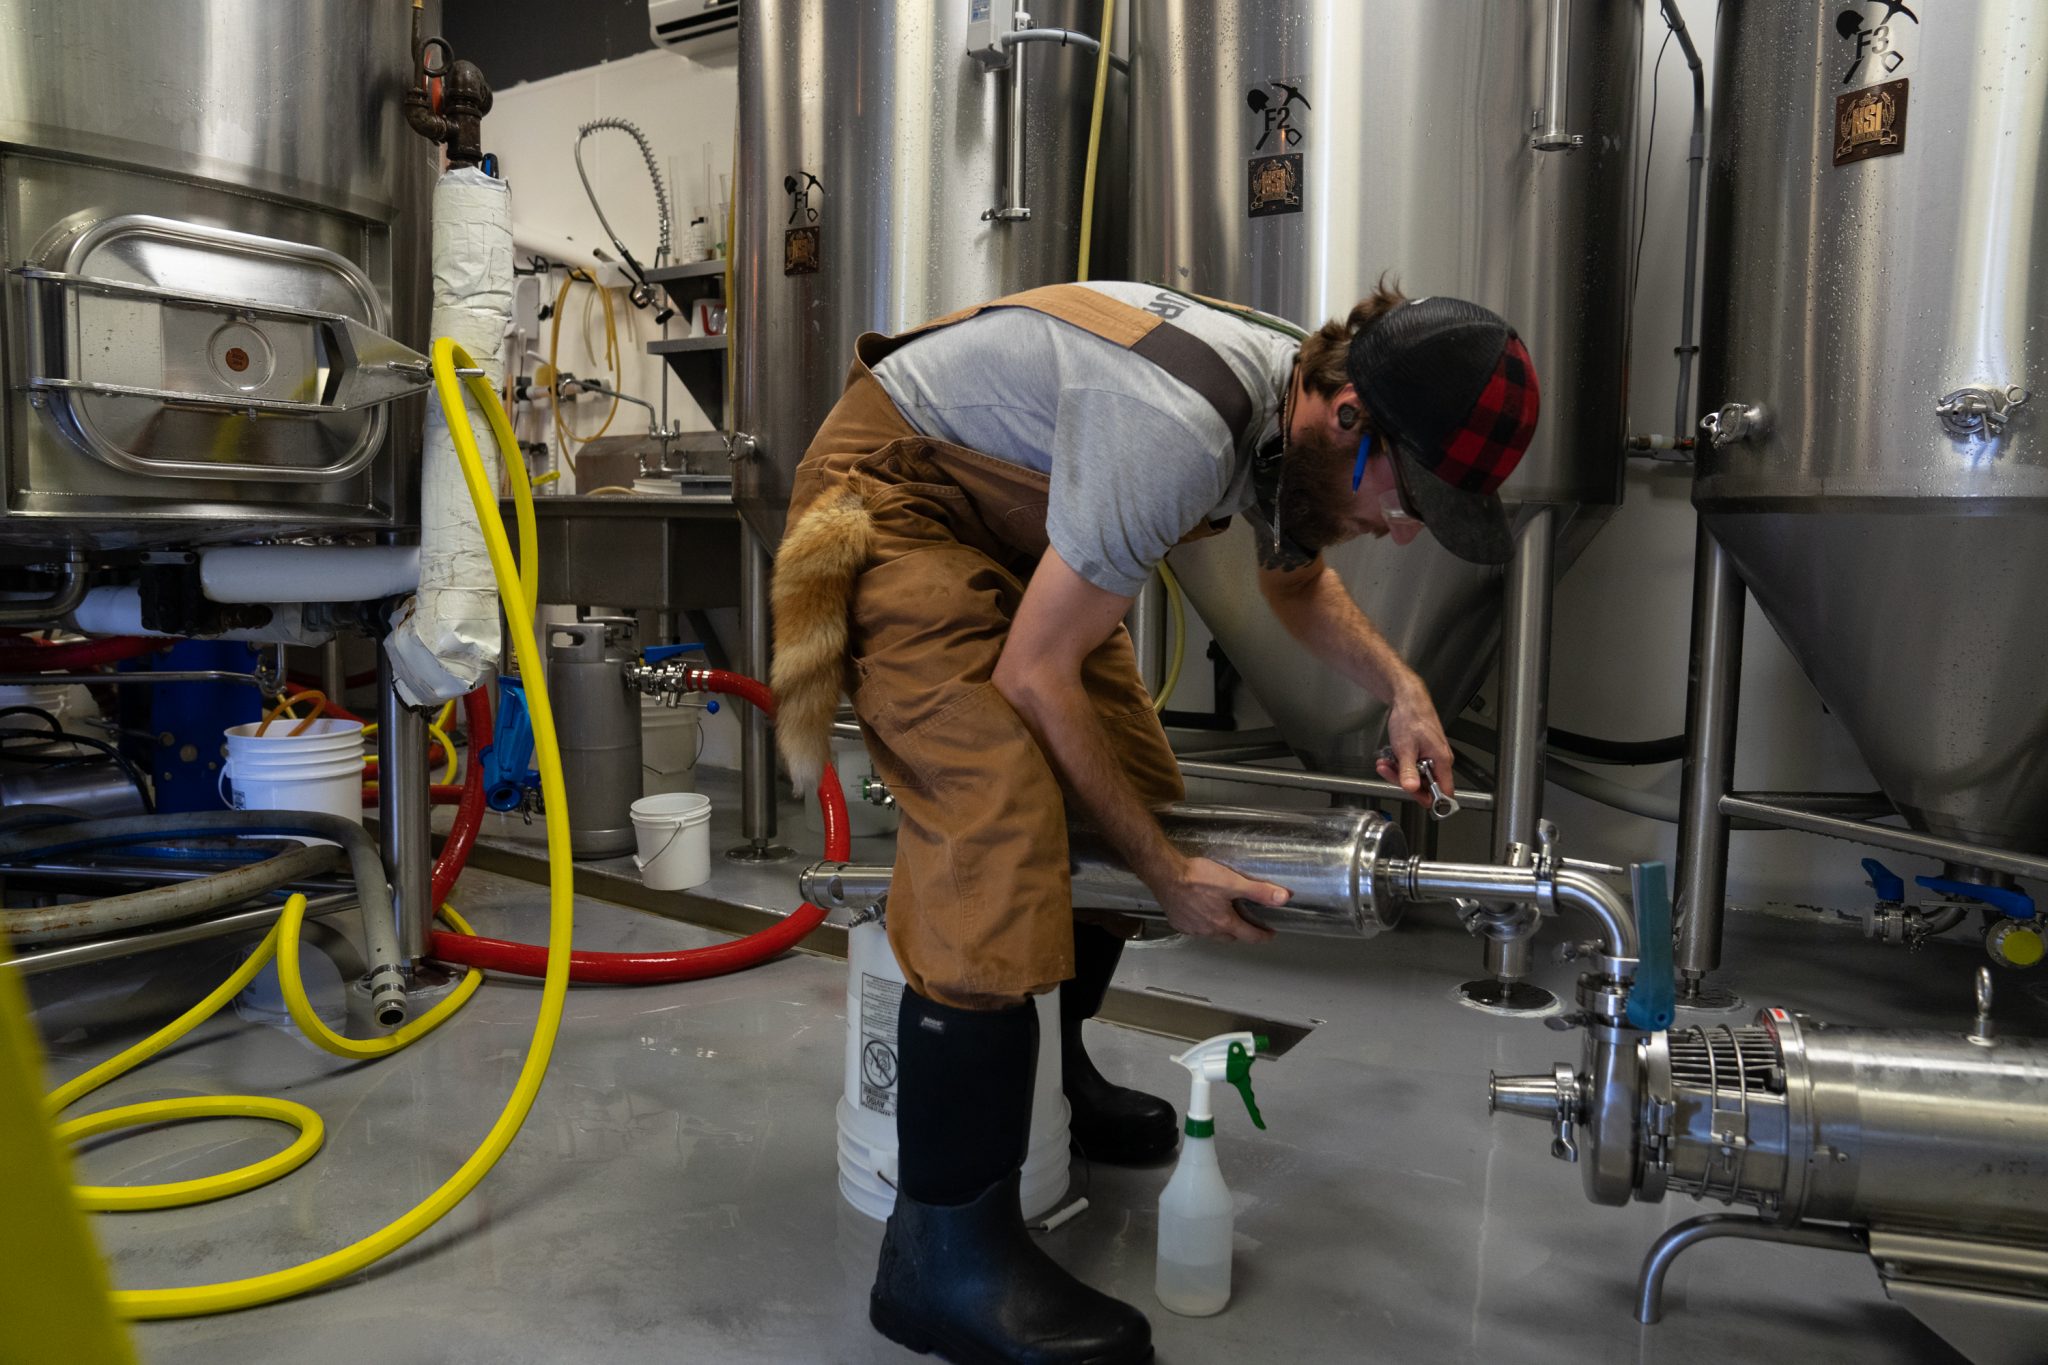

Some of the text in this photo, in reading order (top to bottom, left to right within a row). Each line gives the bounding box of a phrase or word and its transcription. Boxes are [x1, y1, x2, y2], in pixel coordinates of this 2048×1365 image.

[1856, 25, 1890, 61] F3
[1265, 107, 1290, 132] F2
[1852, 101, 1883, 136] NSI
[794, 191, 808, 209] F1
